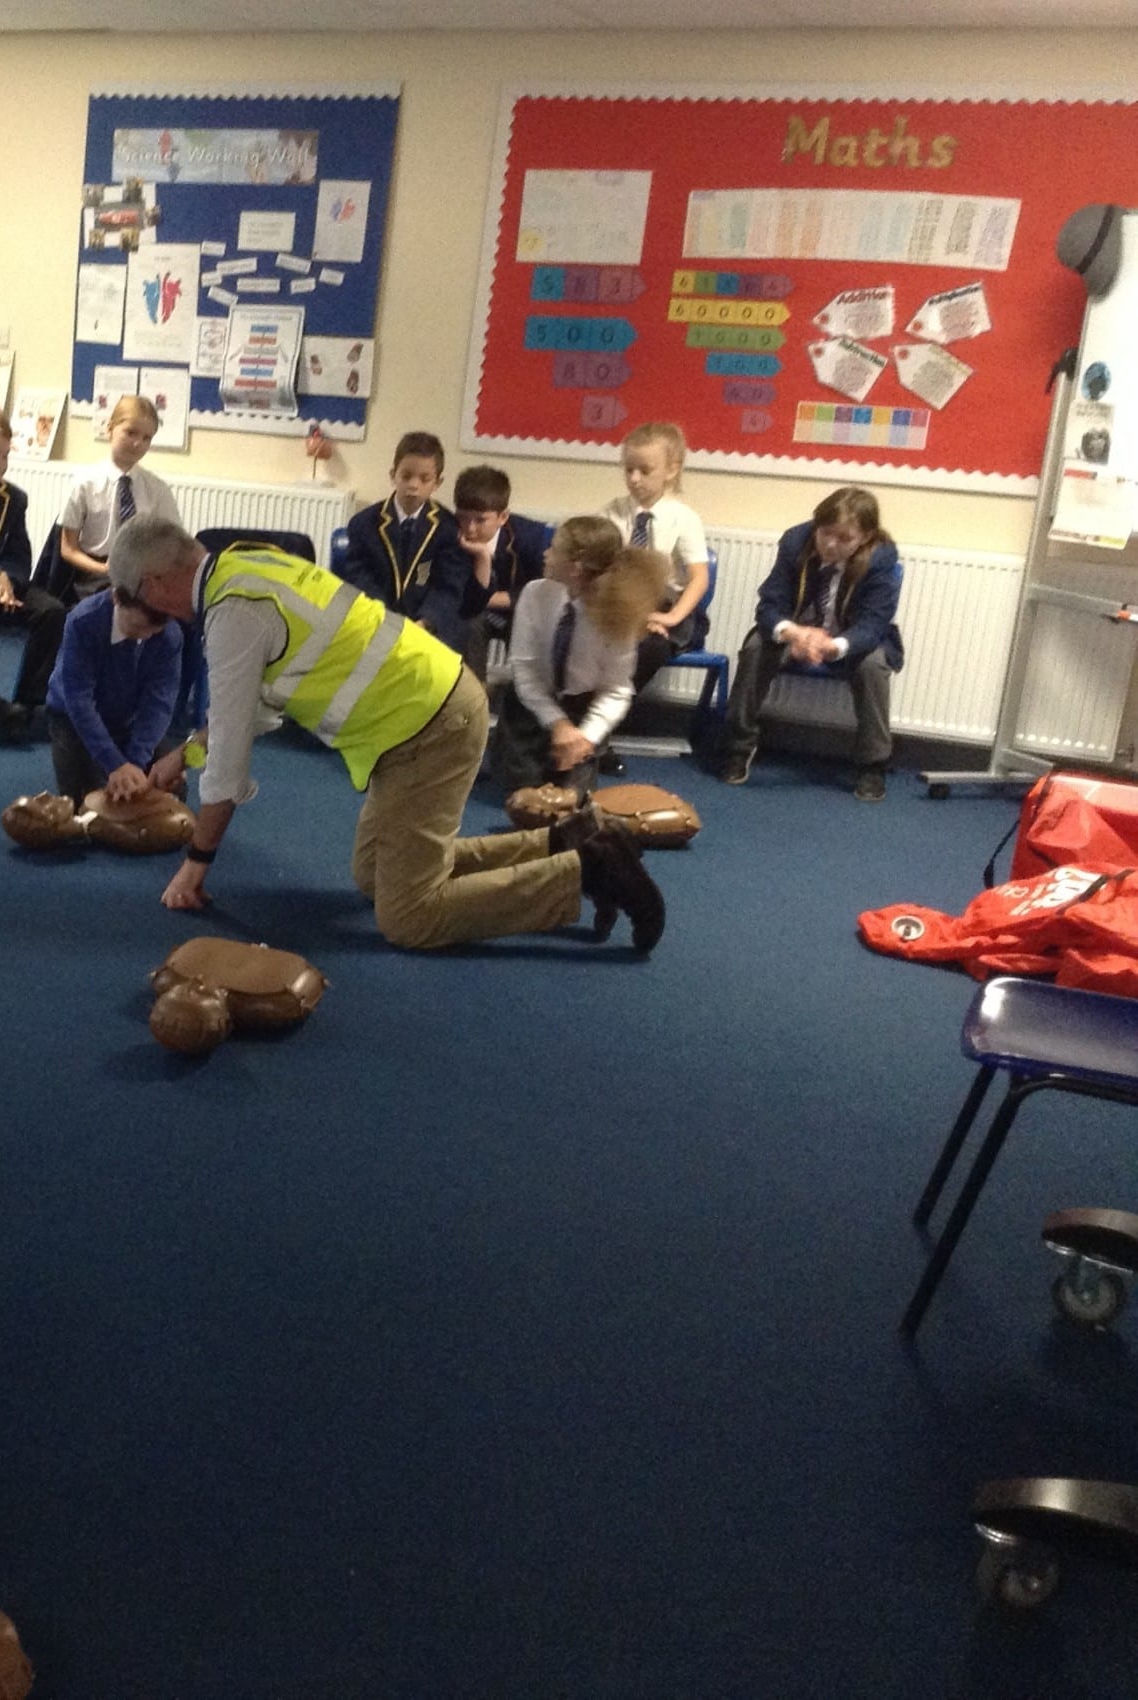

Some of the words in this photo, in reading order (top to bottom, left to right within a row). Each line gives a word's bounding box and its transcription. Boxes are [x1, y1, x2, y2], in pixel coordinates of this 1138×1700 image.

[189, 146, 261, 168] Working
[270, 142, 312, 164] Wall
[781, 114, 958, 168] Maths
